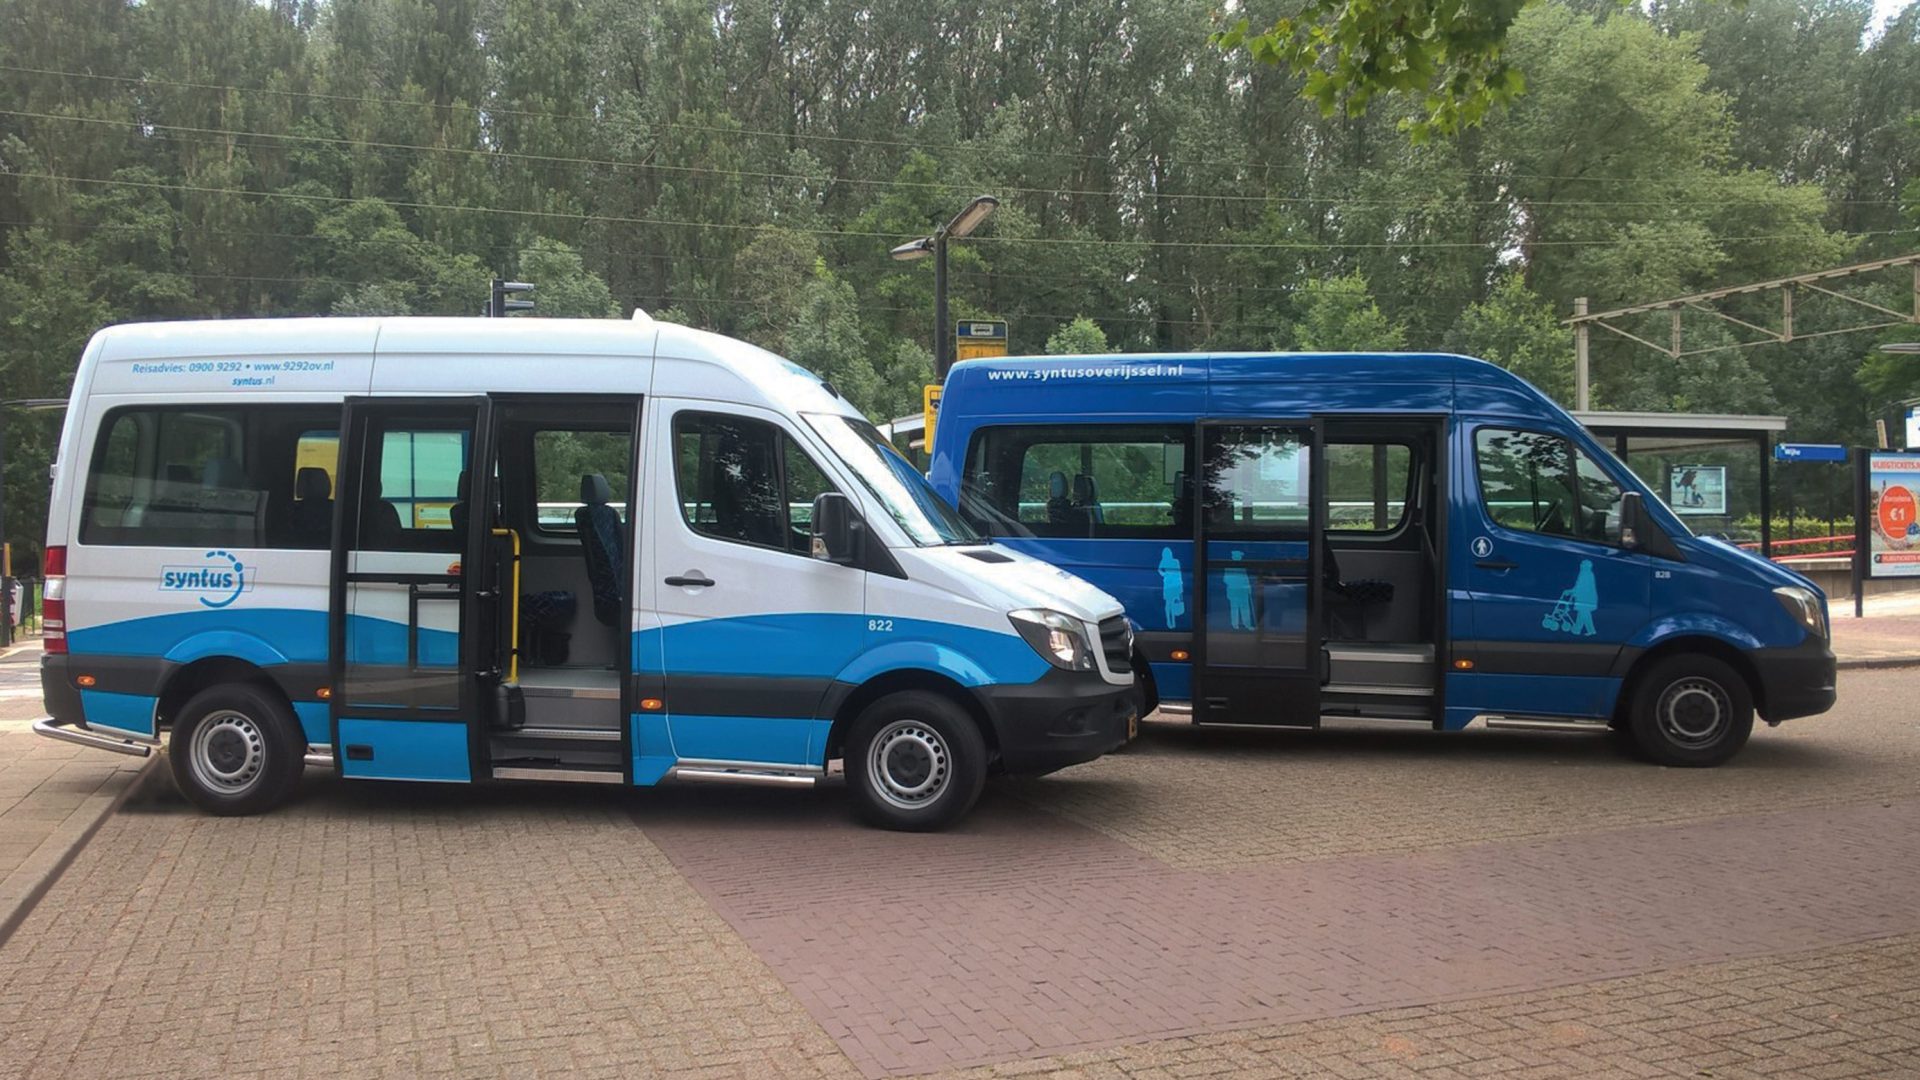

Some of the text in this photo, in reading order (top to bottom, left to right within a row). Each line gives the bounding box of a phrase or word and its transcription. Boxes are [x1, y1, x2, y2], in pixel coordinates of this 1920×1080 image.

[132, 360, 335, 374] Reisadvies: 0900 9292 www.9292ov.nl
[987, 364, 1184, 382] www.syntusoverijssel.nl
[231, 375, 276, 387] syntus.nl
[164, 568, 233, 589] syntus
[868, 619, 893, 632] 822
